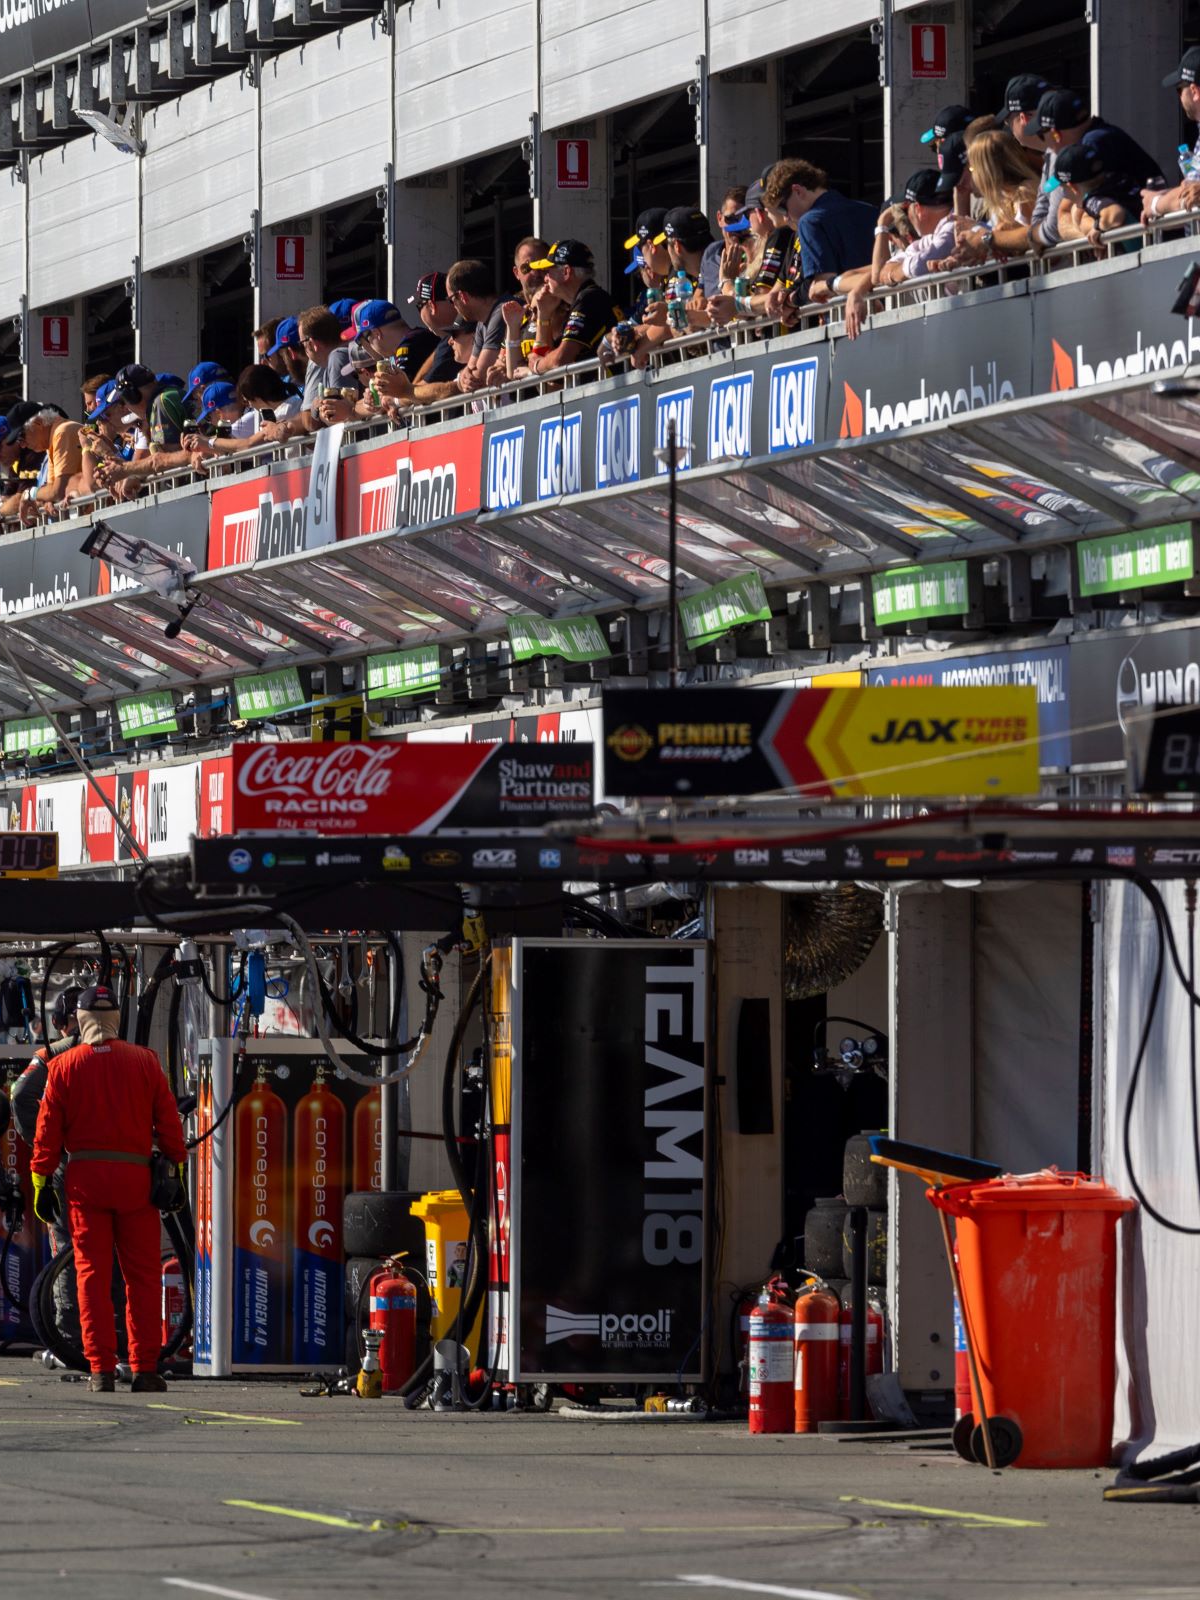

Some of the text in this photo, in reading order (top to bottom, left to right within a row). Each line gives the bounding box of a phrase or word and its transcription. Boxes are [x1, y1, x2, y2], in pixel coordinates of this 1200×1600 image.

[710, 376, 751, 460] LIQUI
[771, 366, 816, 448] LIQUI
[538, 414, 581, 500] LIQUI
[597, 402, 639, 485] LIQUI
[488, 434, 523, 509] LIQUI
[658, 723, 751, 744] PENRITE
[870, 717, 1028, 743] JAX TYRES
[974, 731, 1028, 744] AUTO
[499, 758, 591, 779] Shaw and
[659, 746, 722, 759] RACING
[237, 744, 400, 797] Coca-Cola
[500, 778, 590, 797] Partners
[265, 799, 368, 813] RACING
[501, 801, 590, 812] Financial Services
[277, 818, 356, 830] by erebus
[253, 1117, 268, 1216] coregas
[312, 1117, 327, 1216] coregas
[254, 1268, 268, 1346] NITROGEN 4.0
[313, 1268, 327, 1346] NITROGEN 4.0
[601, 1309, 671, 1341] paoli
[608, 1333, 671, 1341] PIT STOP
